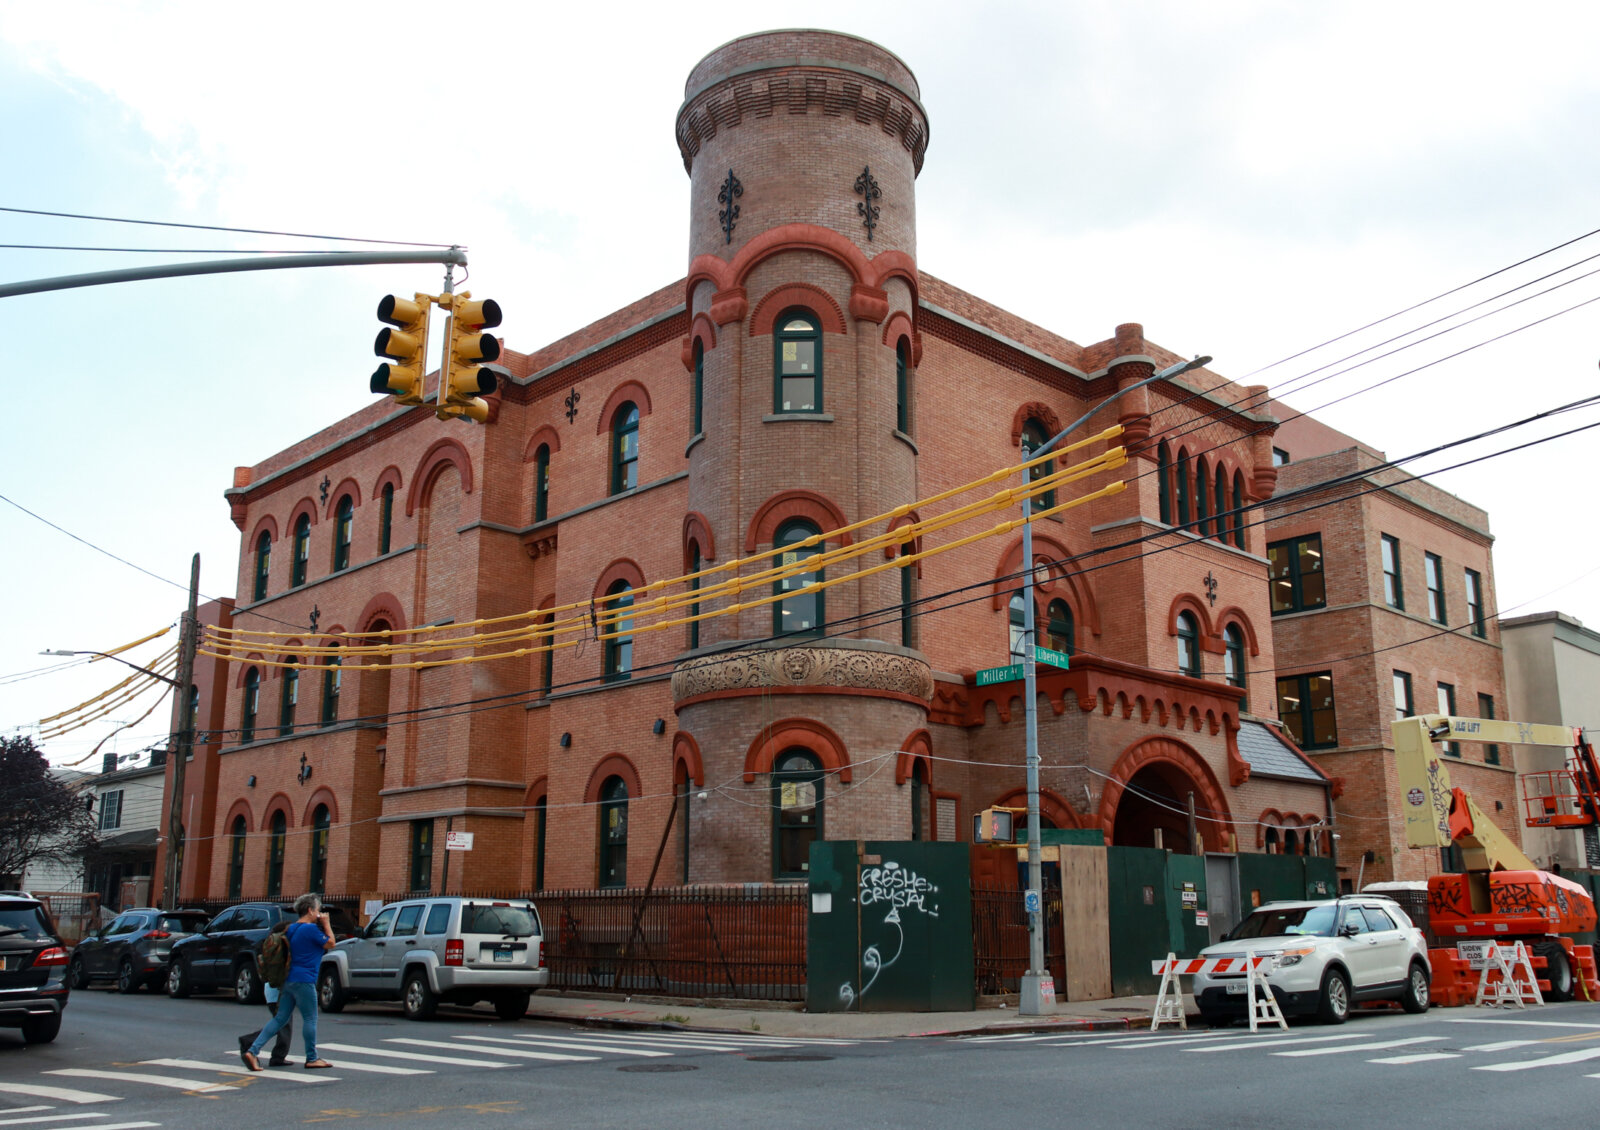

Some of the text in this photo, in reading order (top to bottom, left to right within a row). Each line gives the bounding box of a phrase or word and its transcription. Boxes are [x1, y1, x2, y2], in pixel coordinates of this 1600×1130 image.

[1037, 647, 1059, 667] Liberty
[983, 668, 1008, 683] Miller
[1455, 721, 1481, 734] JLG LIFT
